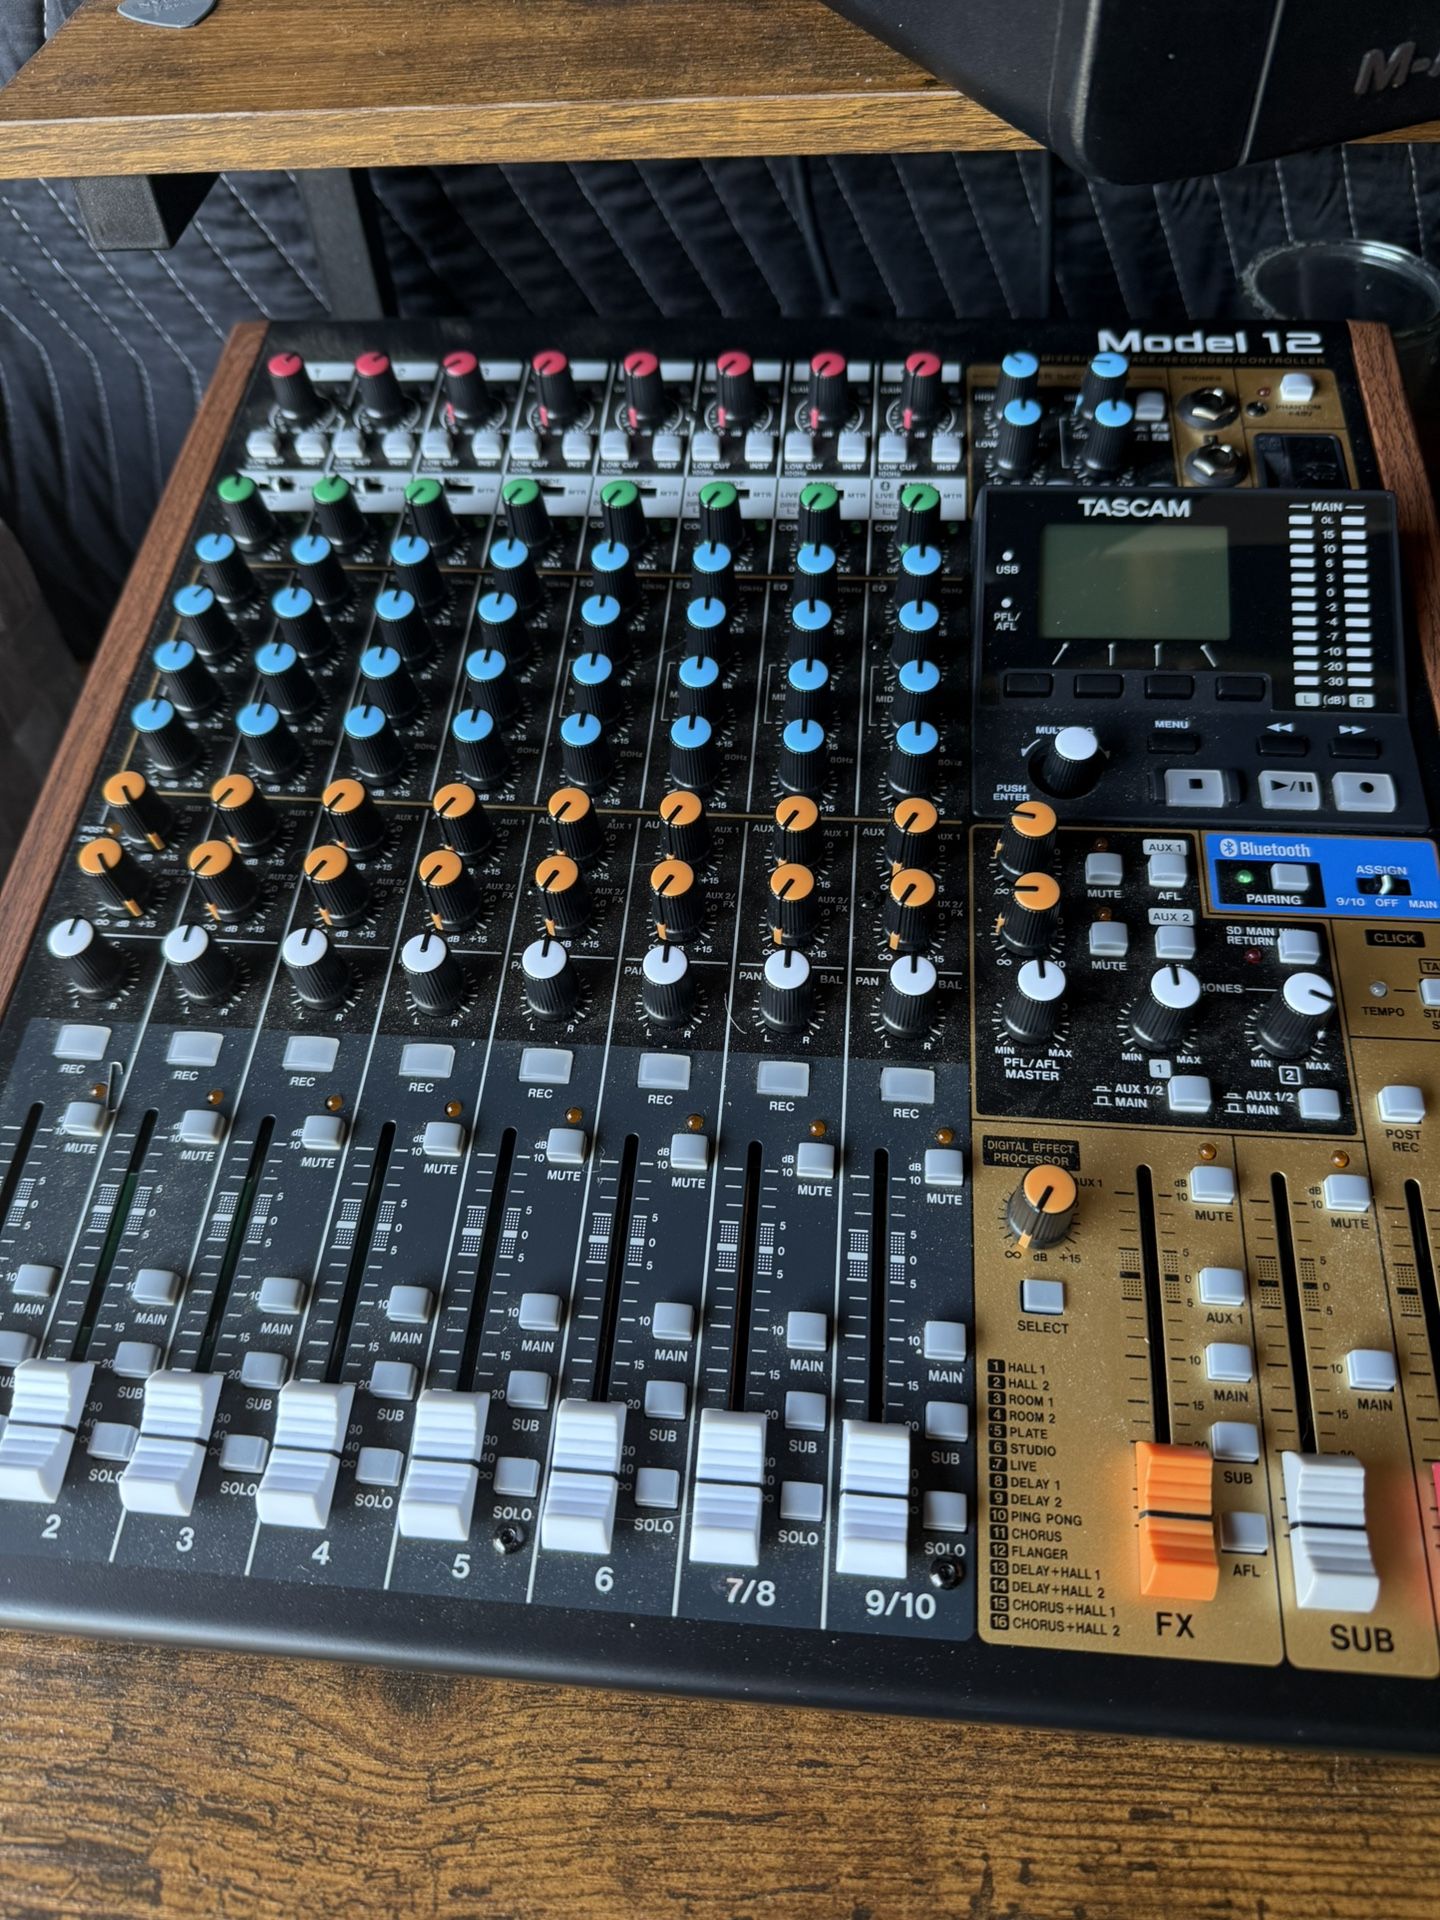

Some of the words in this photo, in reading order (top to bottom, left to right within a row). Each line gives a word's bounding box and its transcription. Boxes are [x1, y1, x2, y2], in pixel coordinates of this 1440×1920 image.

[1098, 330, 1247, 353] Model
[1262, 332, 1323, 353] 12
[1078, 498, 1190, 517] TASCAM
[1312, 502, 1342, 511] MAIN
[1322, 530, 1335, 539] 15
[1323, 545, 1336, 553] 10
[1325, 559, 1333, 568] 6
[996, 565, 1018, 574] USB
[1326, 573, 1334, 582] 3
[1326, 588, 1335, 597] 0
[1326, 602, 1337, 612] -2
[994, 612, 1020, 621] PFL/
[1326, 617, 1338, 626] -4
[996, 622, 1016, 631] AFL
[1327, 632, 1338, 641] -7
[1324, 647, 1342, 656] -10
[1324, 662, 1343, 671] -20
[1324, 677, 1344, 686] -30
[1304, 695, 1311, 704] L
[1323, 695, 1346, 705] (dB)
[1357, 697, 1365, 705] R
[1155, 720, 1189, 729] MENU
[997, 784, 1026, 792] PUSH
[993, 793, 1030, 801] ENTER
[1149, 844, 1173, 852] AUX
[1177, 844, 1181, 852] 1
[1240, 842, 1311, 857] Bluetooth
[1356, 865, 1407, 875] ASSIGN
[1088, 889, 1122, 898] MUTE
[1158, 892, 1182, 900] AFL
[1246, 894, 1302, 905] PAIRING
[1336, 897, 1365, 906] 9/10
[1375, 898, 1398, 907] OFF
[1409, 900, 1438, 908] MAIN
[1153, 913, 1178, 921] AUX
[1183, 914, 1190, 922] 2
[1226, 926, 1242, 934] SD
[1246, 927, 1275, 936] MAIN
[1227, 936, 1275, 946] RETURN
[1374, 933, 1416, 944] CLICK
[1092, 960, 1127, 971] MUTE
[856, 977, 879, 986] PAN
[938, 980, 962, 990] BAL
[1361, 1006, 1405, 1017] TEMPO
[995, 1046, 1014, 1054] MIN
[1048, 1049, 1072, 1057] MAX
[1122, 1053, 1142, 1061] MIN
[1177, 1056, 1201, 1064] MAX
[1004, 1057, 1060, 1069] PFL/AFL
[1251, 1059, 1272, 1067] MIN
[1305, 1062, 1330, 1070] MAX
[60, 1064, 85, 1074] REC
[1006, 1069, 1059, 1081] MASTER
[1286, 1070, 1295, 1080] 2
[289, 1077, 315, 1087] REC
[528, 1088, 553, 1099] REC
[1115, 1084, 1141, 1094] AUX
[1144, 1085, 1165, 1095] 1/2
[1246, 1091, 1271, 1101] AUX
[1275, 1092, 1295, 1102] 1/2
[770, 1101, 794, 1112] REC
[1115, 1097, 1147, 1108] MAIN
[893, 1108, 919, 1119] REC
[1246, 1104, 1279, 1115] MAIN
[1385, 1129, 1421, 1140] POST
[64, 1143, 98, 1154] MUTE
[988, 1140, 1028, 1152] DIGITAL
[1033, 1141, 1074, 1154] EFFECT
[1392, 1142, 1419, 1152] REC
[301, 1157, 336, 1168] MUTE
[994, 1153, 1069, 1167] PROCESSOR
[424, 1163, 458, 1174] MUTE
[672, 1177, 706, 1188] MUTE
[927, 1193, 962, 1205] MUTE
[1195, 1210, 1234, 1222] MUTE
[1331, 1218, 1370, 1229] MUTE
[1033, 1253, 1048, 1262] dB
[1059, 1254, 1081, 1263] +15
[13, 1302, 45, 1315] MAIN
[135, 1312, 167, 1325] MAIN
[1206, 1312, 1234, 1324] AUX
[1237, 1314, 1243, 1325] 1
[1017, 1320, 1069, 1334] SELECT
[390, 1331, 423, 1344] MAIN
[655, 1349, 688, 1362] MAIN
[993, 1361, 998, 1371] 1
[1008, 1362, 1037, 1374] HALL
[1040, 1365, 1045, 1374] 1
[929, 1370, 962, 1383] MAIN
[993, 1393, 1001, 1403] 3
[1009, 1394, 1043, 1406] ROOM
[1048, 1397, 1053, 1407] 1
[1214, 1390, 1248, 1402] MAIN
[246, 1398, 272, 1411] SUB
[1358, 1398, 1393, 1411] MAIN
[378, 1409, 404, 1422] SUB
[650, 1429, 677, 1442] SUB
[994, 1426, 1002, 1436] 5
[1010, 1427, 1048, 1440] PLATE
[790, 1440, 817, 1453] SUB
[994, 1442, 1002, 1452] 6
[1010, 1443, 1056, 1457] STUDIO
[932, 1452, 960, 1465] SUB
[994, 1459, 1002, 1469] 7
[1010, 1460, 1037, 1472] LIVE
[994, 1475, 1003, 1486] 8
[1011, 1477, 1049, 1489] DELAY
[1055, 1480, 1060, 1490] 1
[1223, 1470, 1252, 1484] SUB
[355, 1494, 393, 1509] SOLO
[992, 1510, 1006, 1521] 10
[1011, 1511, 1041, 1523] PING
[1046, 1513, 1082, 1526] PONG
[42, 1514, 61, 1539] 2
[635, 1517, 674, 1533] SOLO
[176, 1527, 194, 1552] 3
[779, 1530, 819, 1545] SOLO
[993, 1527, 1005, 1538] 11
[1012, 1528, 1062, 1542] CHORUS
[312, 1541, 330, 1565] 4
[925, 1542, 966, 1556] SOLO
[992, 1544, 1007, 1555] 12
[1012, 1545, 1068, 1560] FLANGER
[452, 1554, 470, 1578] 5
[992, 1562, 1006, 1573] 13
[1012, 1563, 1092, 1580] DELAY+HALL
[1095, 1570, 1100, 1580] 1
[1232, 1563, 1260, 1577] AFL
[595, 1567, 613, 1593] 6
[727, 1578, 775, 1606] 7/8
[992, 1580, 1007, 1591] 14
[1012, 1581, 1093, 1598] DELAY+HALL
[1098, 1587, 1104, 1599] 2
[865, 1590, 936, 1619] 9/10
[993, 1597, 1007, 1609] 15
[1012, 1599, 1107, 1617] CHORUS+HALL
[1110, 1607, 1115, 1617] 1
[993, 1616, 1007, 1628] 16
[1013, 1617, 1108, 1636] CHORUS+HALL
[1113, 1625, 1120, 1637] 2
[1156, 1612, 1194, 1638] FX
[1330, 1624, 1394, 1653] SUB
